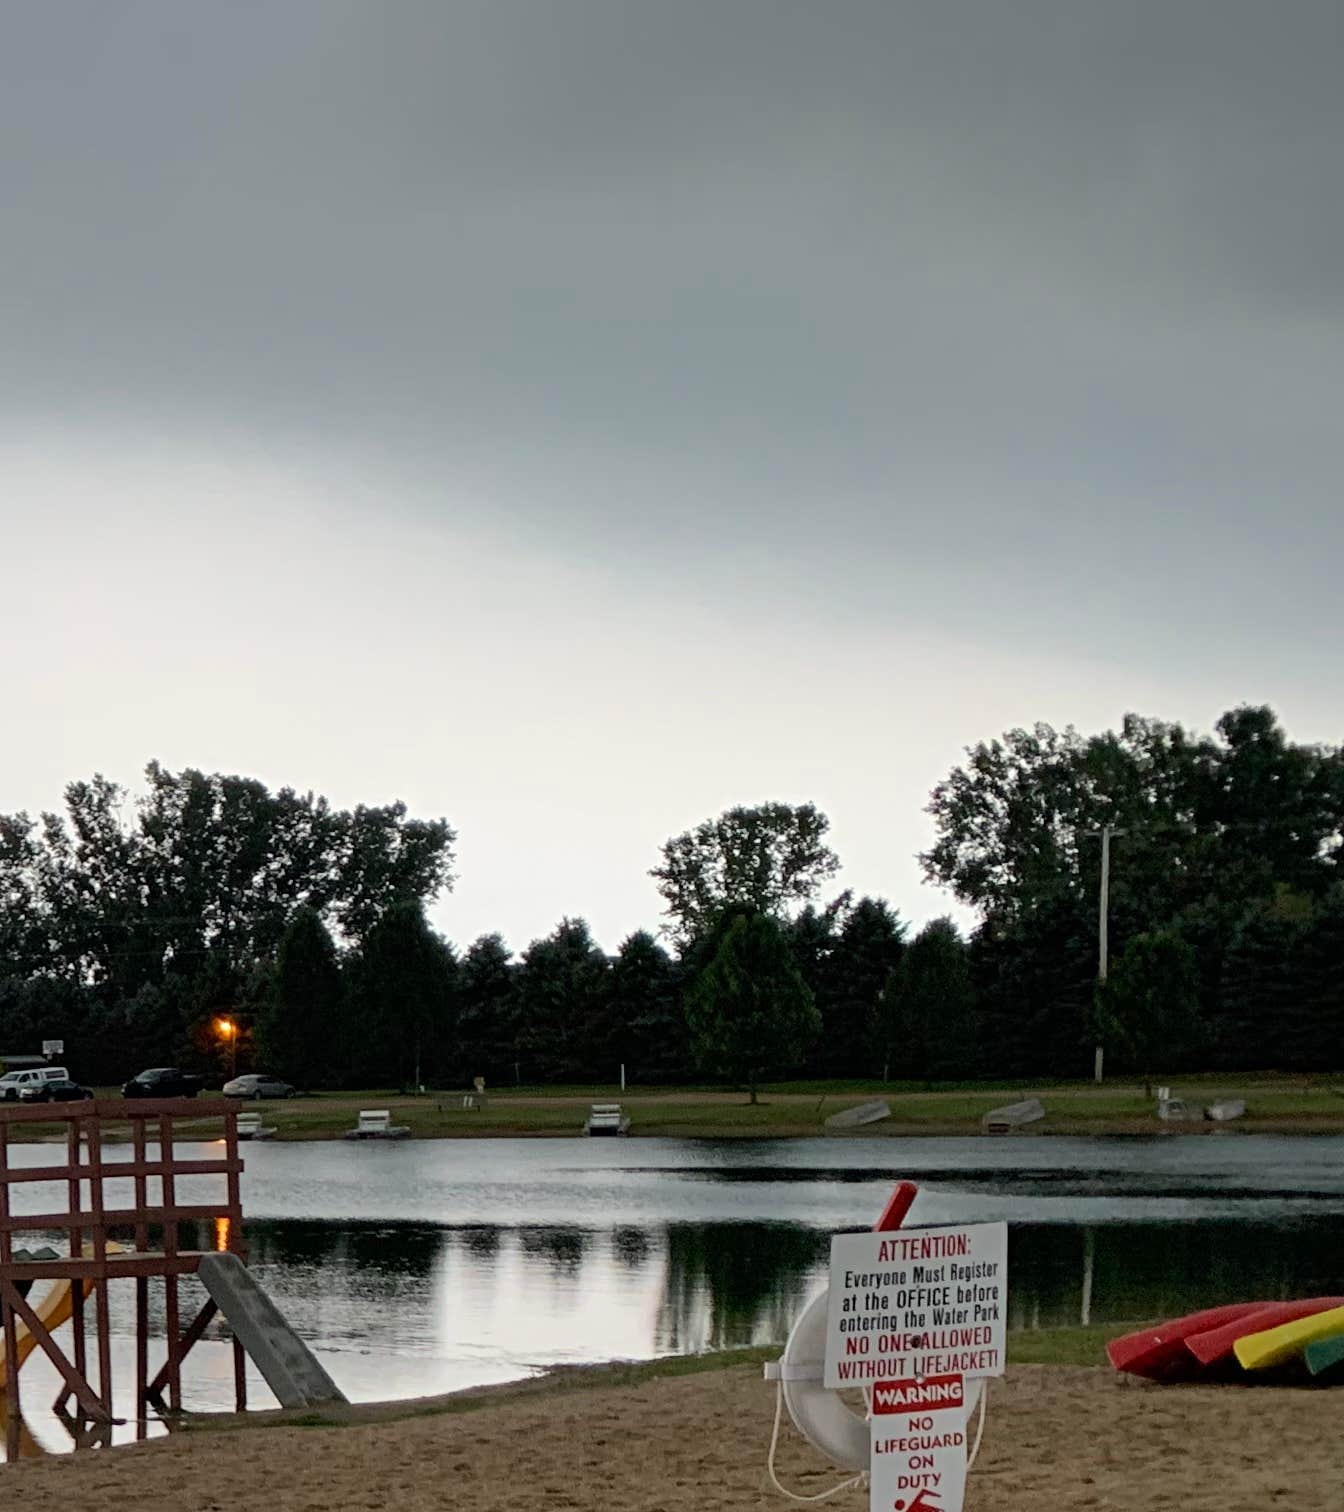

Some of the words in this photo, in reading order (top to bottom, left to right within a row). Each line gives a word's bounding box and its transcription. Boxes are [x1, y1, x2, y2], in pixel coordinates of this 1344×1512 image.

[879, 1233, 971, 1262] ATTENTION:
[845, 1272, 906, 1289] Everyone
[913, 1266, 945, 1283] Must
[950, 1262, 998, 1281] Register
[842, 1298, 857, 1312] at
[865, 1292, 888, 1309] the
[897, 1287, 950, 1308] OFFICE
[957, 1285, 998, 1303] before
[840, 1314, 897, 1332] entering
[904, 1311, 925, 1329] the
[932, 1307, 969, 1327] Water
[974, 1306, 999, 1322] Park
[846, 1337, 869, 1355] NO
[878, 1333, 912, 1352] ONE
[921, 1326, 992, 1350] ALLOWED
[838, 1359, 905, 1379] WITHOUT
[914, 1350, 998, 1375] LIFEJACKET!
[875, 1382, 962, 1405] WARNING
[909, 1417, 933, 1431] NO
[875, 1433, 963, 1453] LIFEGUARD
[908, 1455, 934, 1469] ON
[898, 1473, 941, 1489] DUTY
